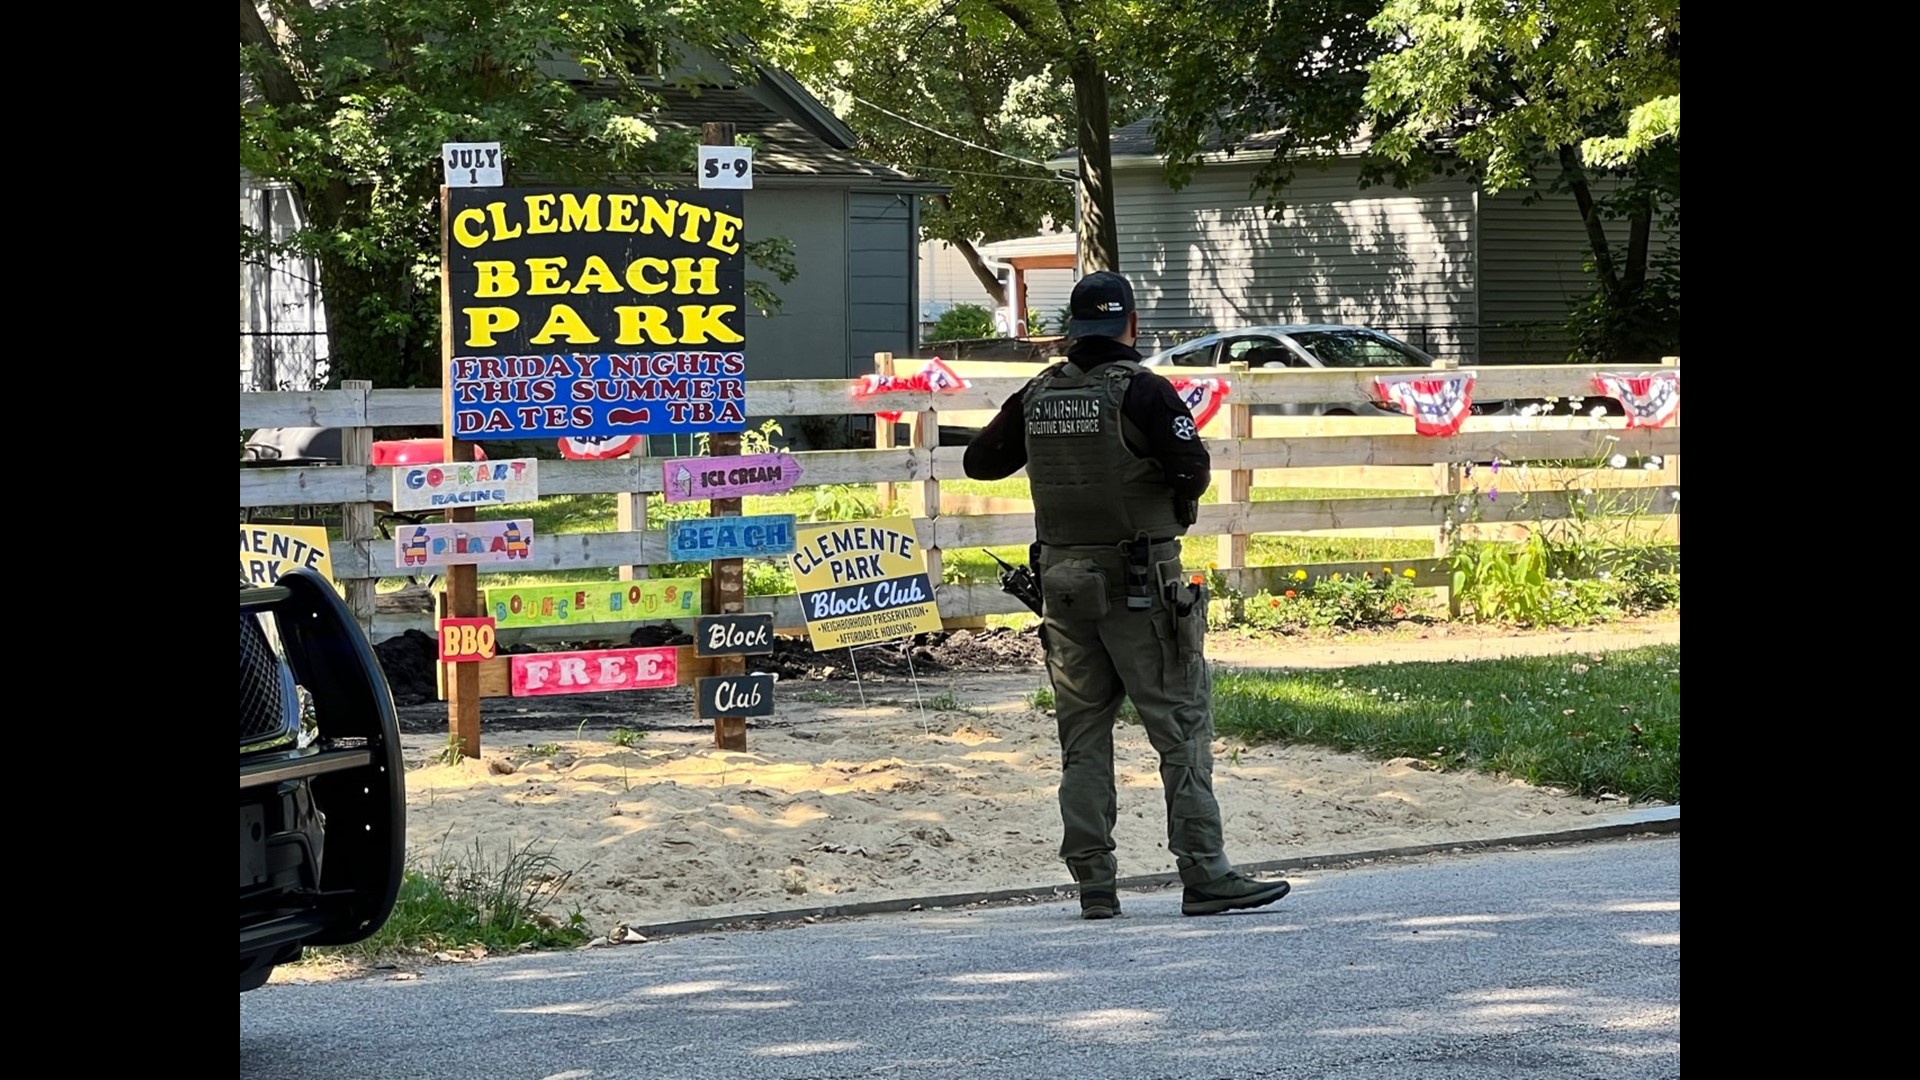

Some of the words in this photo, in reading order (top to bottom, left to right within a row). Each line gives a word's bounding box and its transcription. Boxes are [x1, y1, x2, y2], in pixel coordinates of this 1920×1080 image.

[448, 149, 498, 168] JULY
[704, 158, 748, 178] 5-9
[469, 168, 478, 184] 1
[453, 193, 743, 255] CLEMENTE
[473, 255, 720, 298] BEACH
[462, 303, 745, 347] PARK
[454, 355, 600, 380] FRIDAY
[610, 352, 745, 377] NIGHTS
[455, 379, 557, 403] THIS
[571, 378, 745, 401] SUMMER
[457, 406, 593, 434] DATES
[666, 401, 745, 425] TBA
[1043, 400, 1100, 419] MARSHALS
[1029, 420, 1057, 435] FUGITIVE
[1059, 420, 1075, 433] TASK
[1076, 419, 1100, 433] FORCE
[406, 462, 526, 489] GO-KART
[701, 470, 726, 488] ICE
[729, 466, 782, 487] CREAM
[431, 489, 505, 505] RACING
[677, 523, 787, 550] BEACH
[793, 527, 915, 575] CLEMENTE
[831, 554, 885, 583] PARK
[496, 591, 585, 621] BOUNCE
[610, 585, 693, 613] HOUSE
[811, 585, 871, 618] Block
[874, 578, 926, 607] Club
[443, 624, 496, 659] BBQ
[708, 623, 769, 650] Block
[524, 653, 665, 690] FREE
[714, 681, 762, 711] Club
